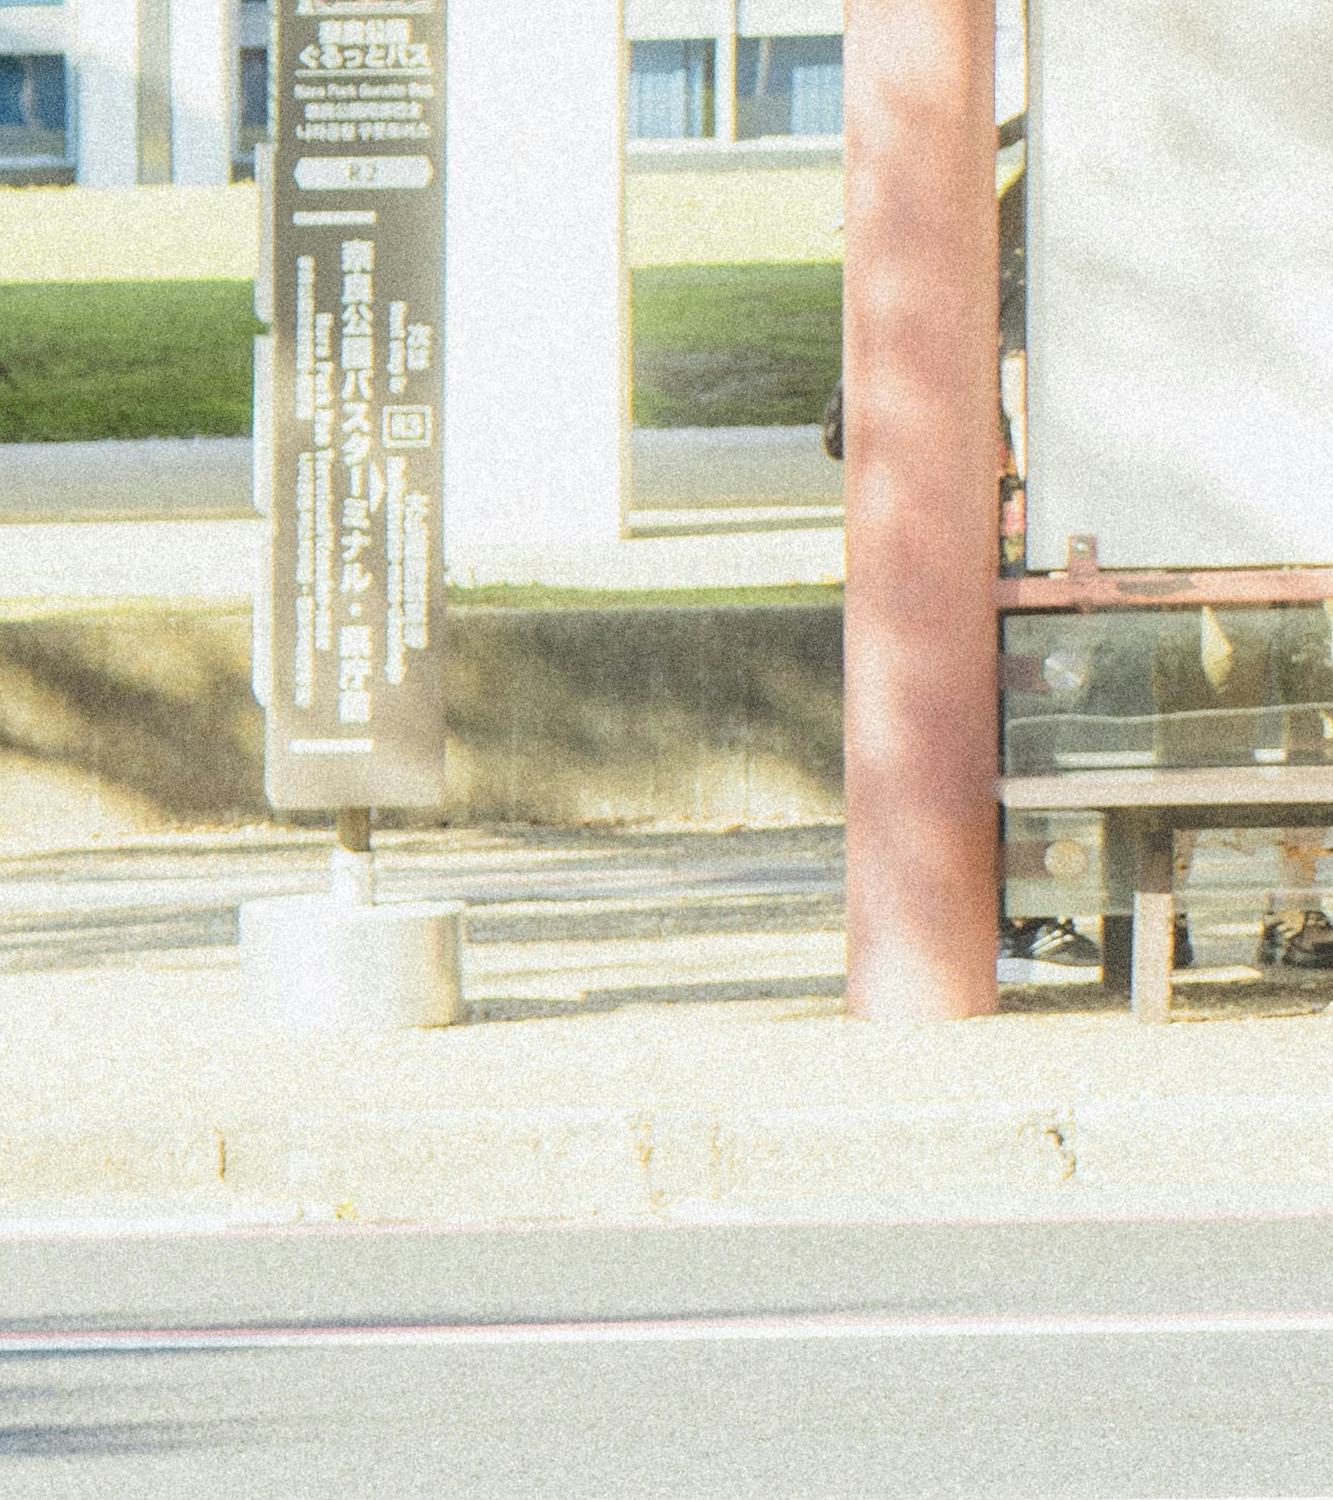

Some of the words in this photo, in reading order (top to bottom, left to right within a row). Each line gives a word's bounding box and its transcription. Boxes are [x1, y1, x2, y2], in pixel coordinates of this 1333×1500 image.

[299, 43, 431, 68] ぐるっとバス
